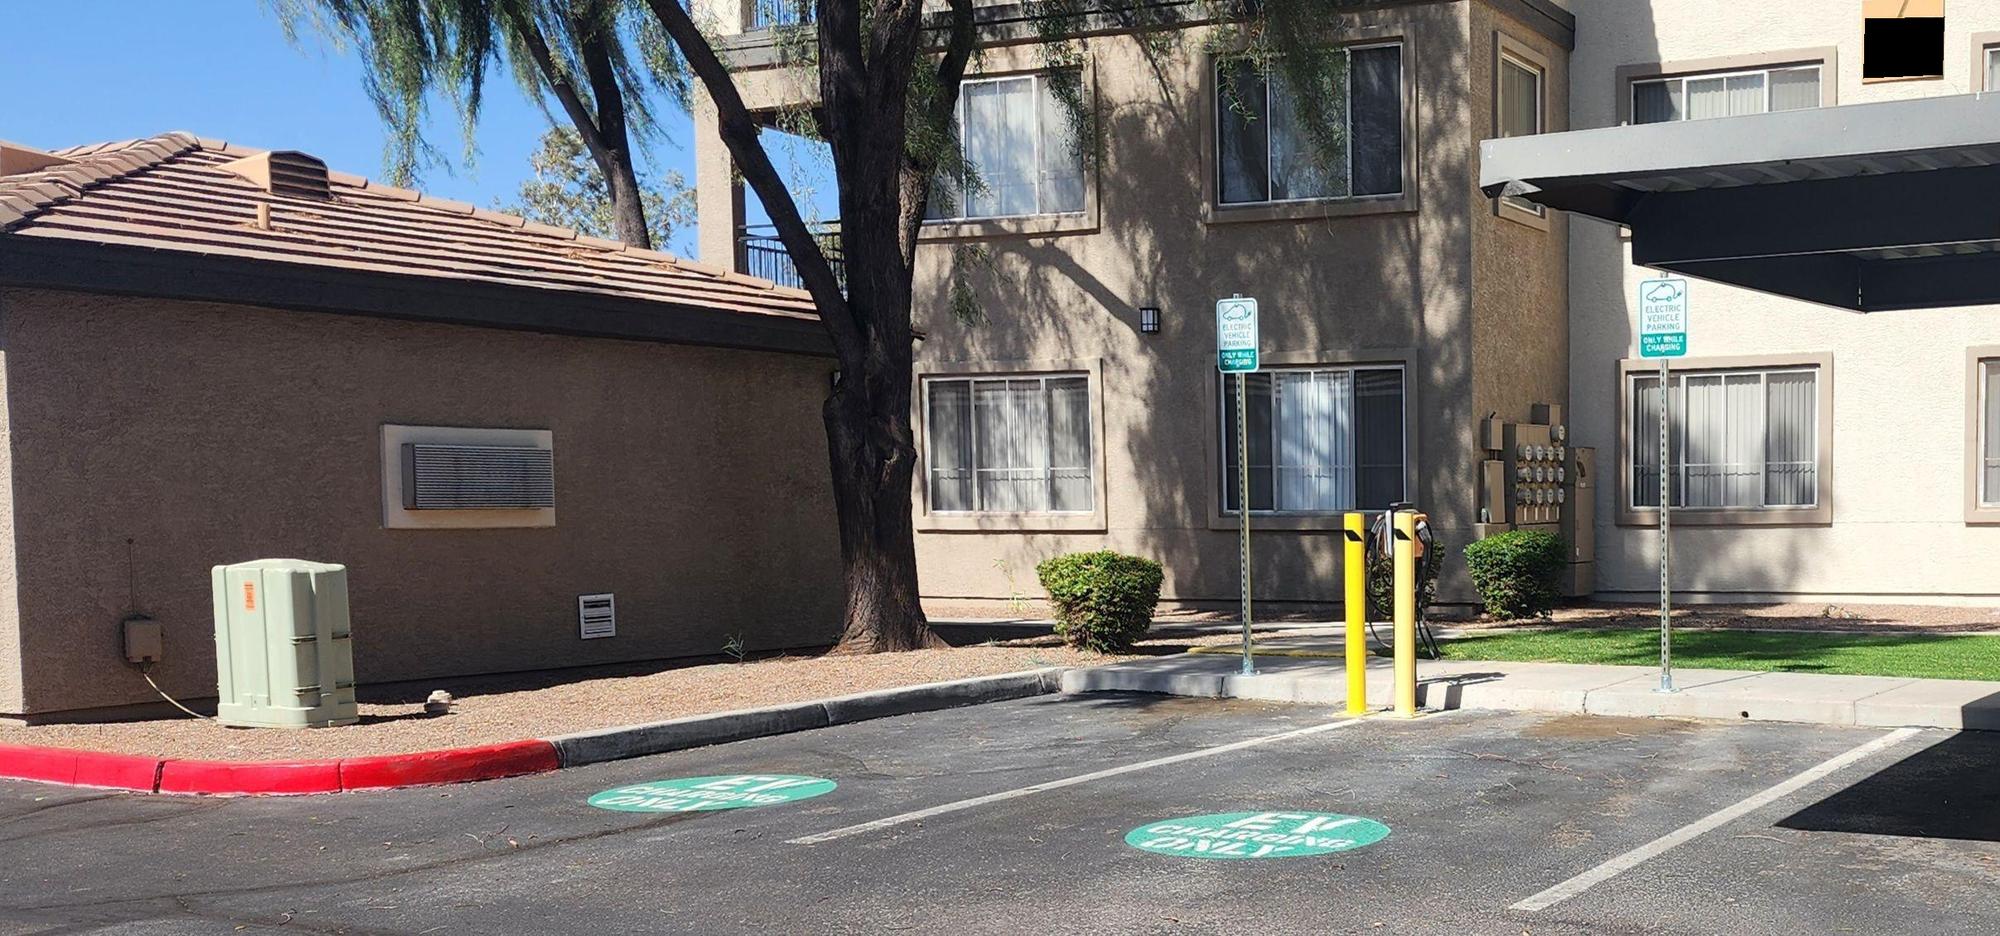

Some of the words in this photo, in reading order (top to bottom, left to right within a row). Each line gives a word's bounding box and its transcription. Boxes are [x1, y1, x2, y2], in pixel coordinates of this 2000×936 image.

[1645, 305, 1681, 314] ELECTRIC
[1647, 313, 1680, 322] VEHICLE
[1222, 323, 1252, 331] ELECTRIC
[1646, 323, 1680, 331] PARKING
[1642, 336, 1662, 345] ONLY
[1663, 335, 1684, 343] WHILE
[1646, 343, 1680, 352] CHARGING
[1221, 351, 1237, 359] ONLY
[690, 774, 832, 792] EV
[1222, 813, 1361, 834] EV
[1147, 824, 1355, 849] CHARGING
[1140, 836, 1295, 857] ONLY
